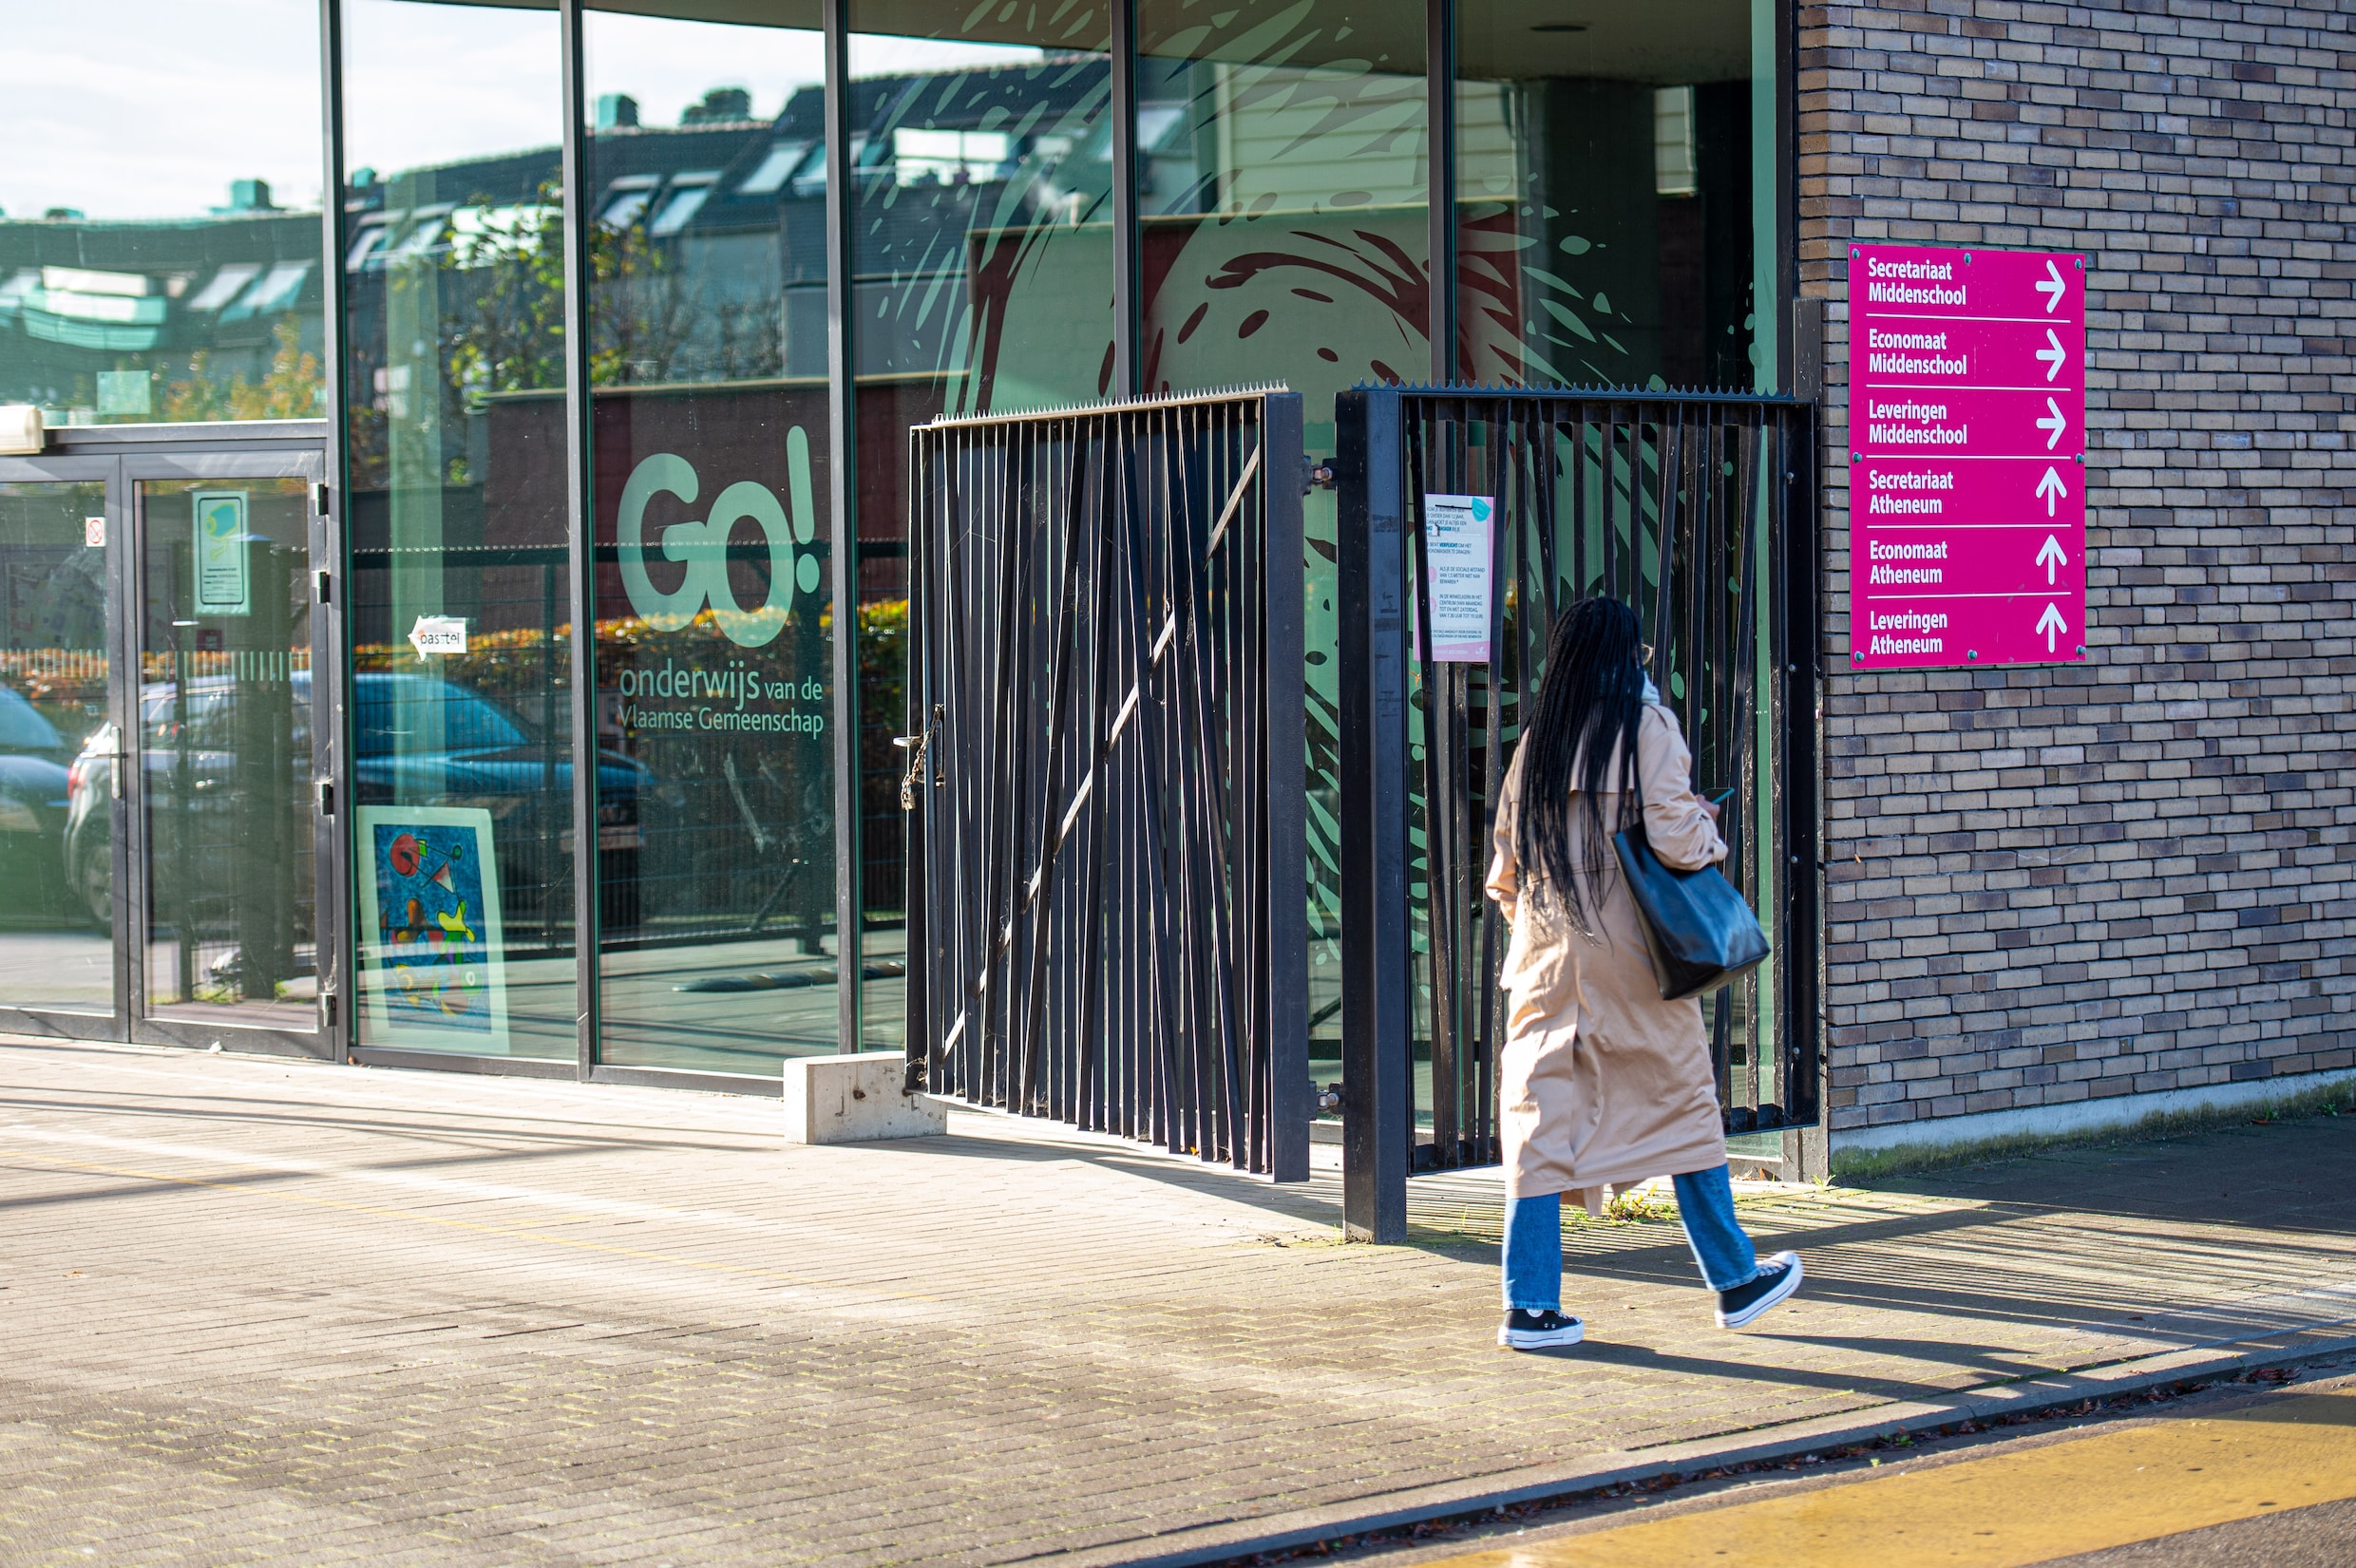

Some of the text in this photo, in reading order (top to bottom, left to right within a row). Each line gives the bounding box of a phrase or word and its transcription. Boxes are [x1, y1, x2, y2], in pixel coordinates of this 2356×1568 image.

[1868, 256, 1952, 280] Secretariaat
[1868, 282, 1966, 305] Middenschool
[1869, 328, 1947, 350] Economaat
[1869, 352, 1967, 375] Middenschool
[1869, 399, 1948, 425] Leveringen
[1869, 424, 1967, 444] Middenschool
[1869, 469, 1953, 490] Secretariaat
[1869, 494, 1943, 514] Atheneum
[1869, 539, 1948, 559] Economaat
[1869, 564, 1943, 584] Atheneum
[1869, 609, 1948, 633] Leveringen
[1869, 634, 1943, 654] Atheneum
[619, 657, 823, 711] onderwijs van de
[618, 705, 824, 740] Vlaamse Gemeenschap
